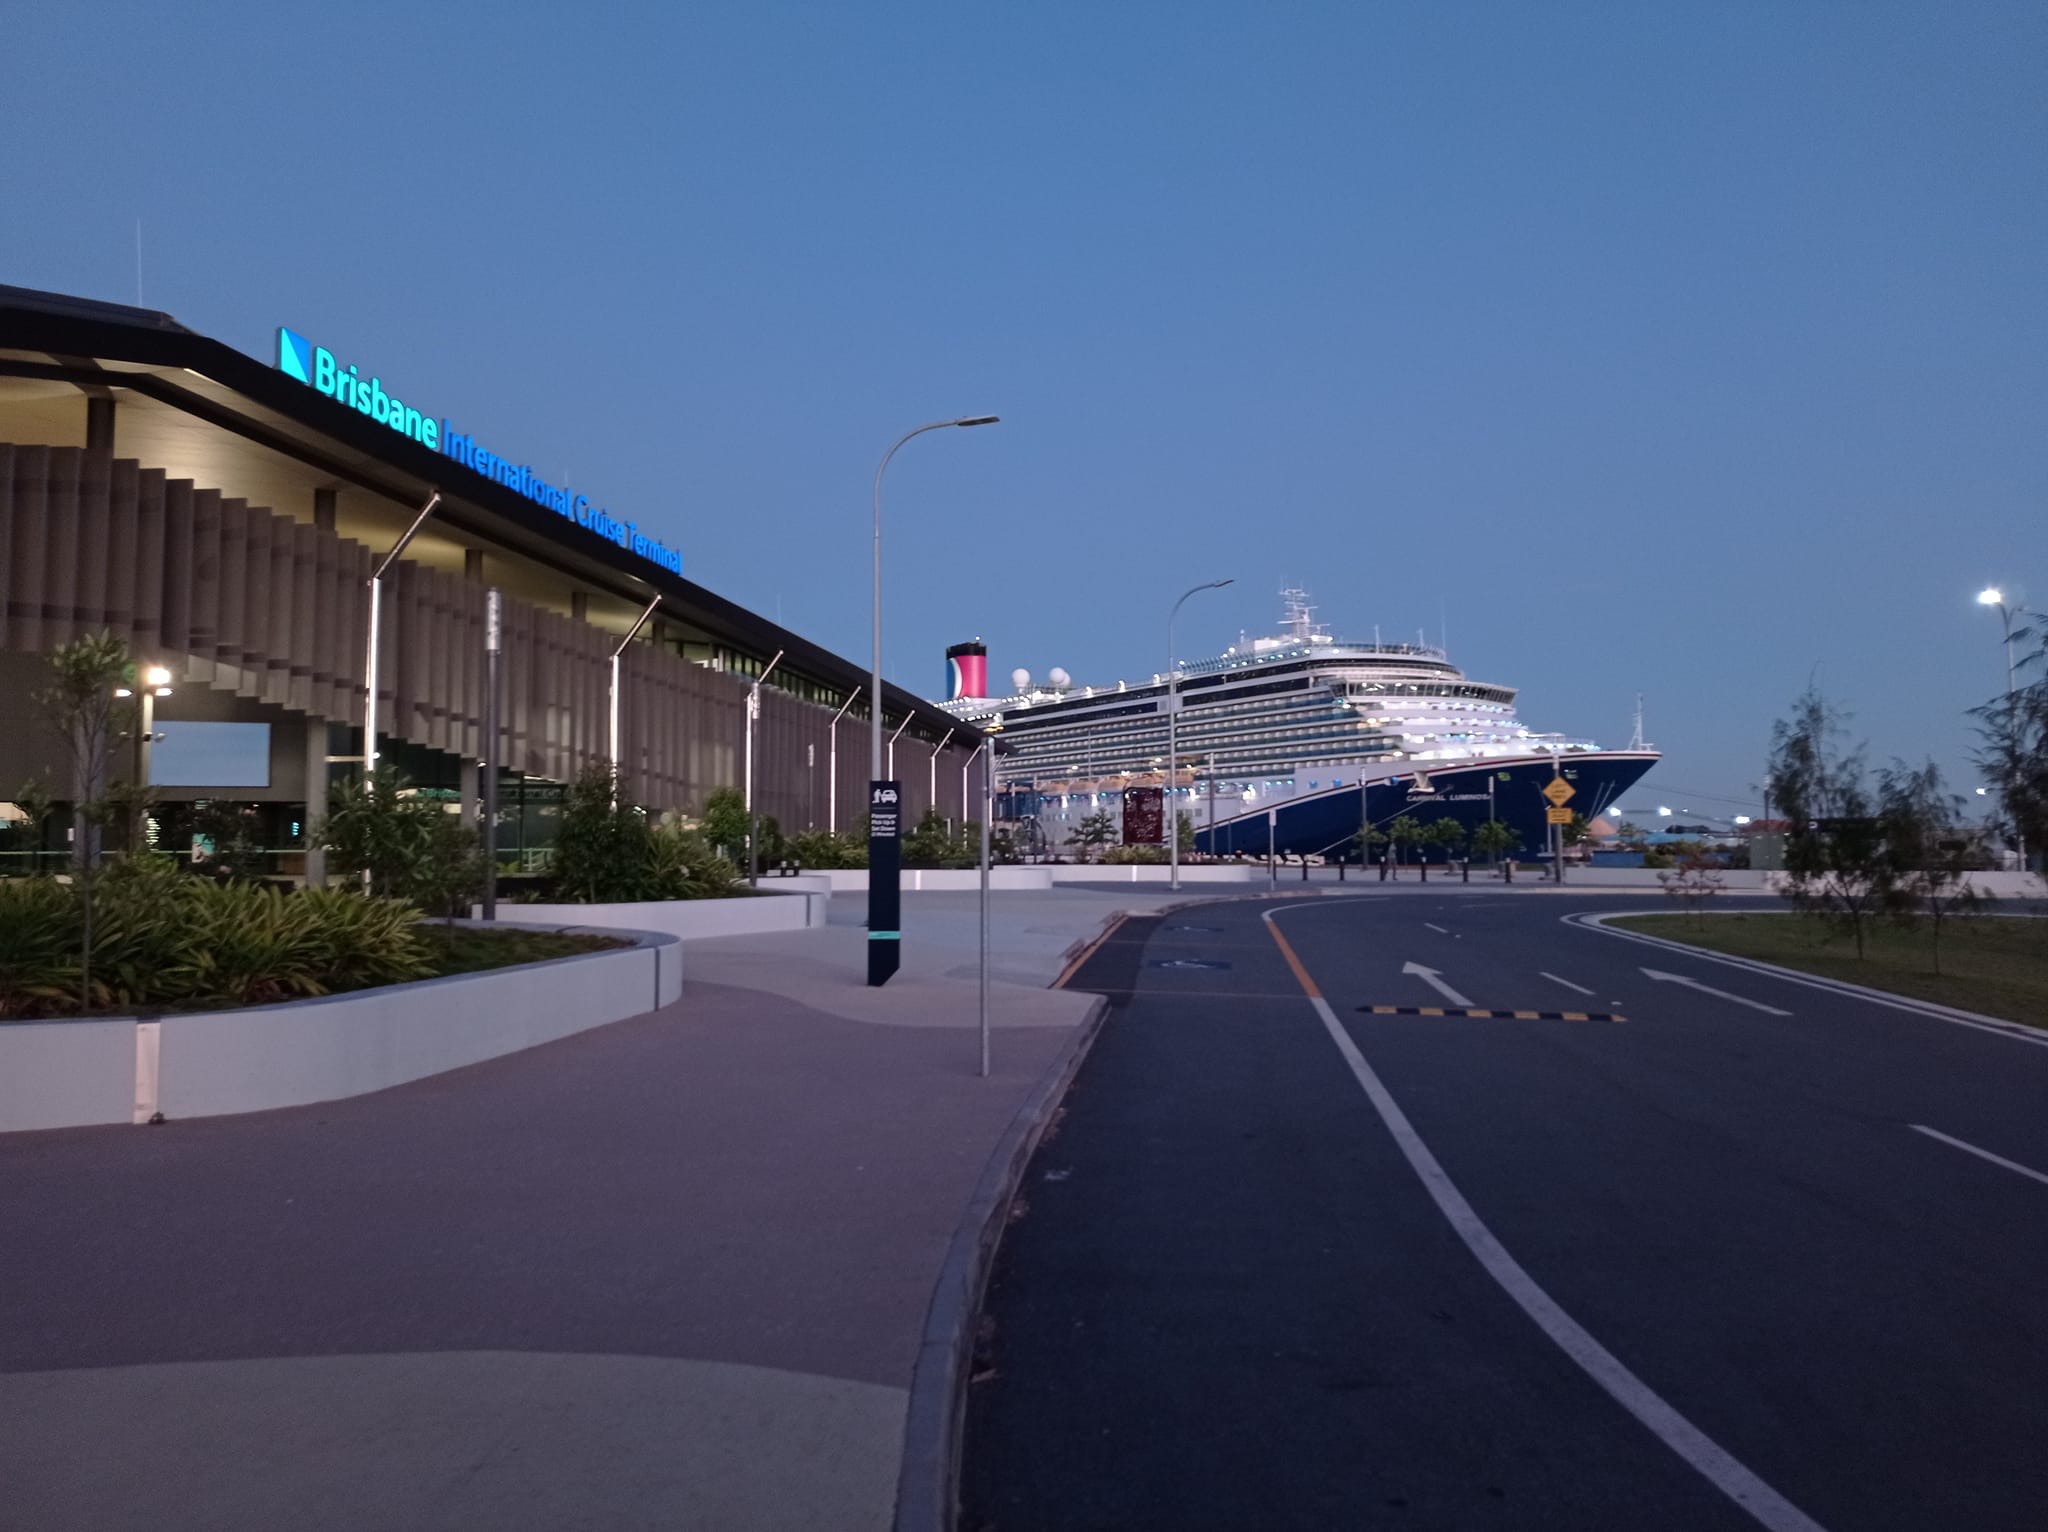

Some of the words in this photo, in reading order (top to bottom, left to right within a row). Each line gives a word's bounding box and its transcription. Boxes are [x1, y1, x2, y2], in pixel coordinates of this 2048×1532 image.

[314, 345, 438, 449] Brisbane
[441, 418, 573, 521] International
[573, 494, 625, 547] Cruise
[626, 521, 682, 575] Terminal
